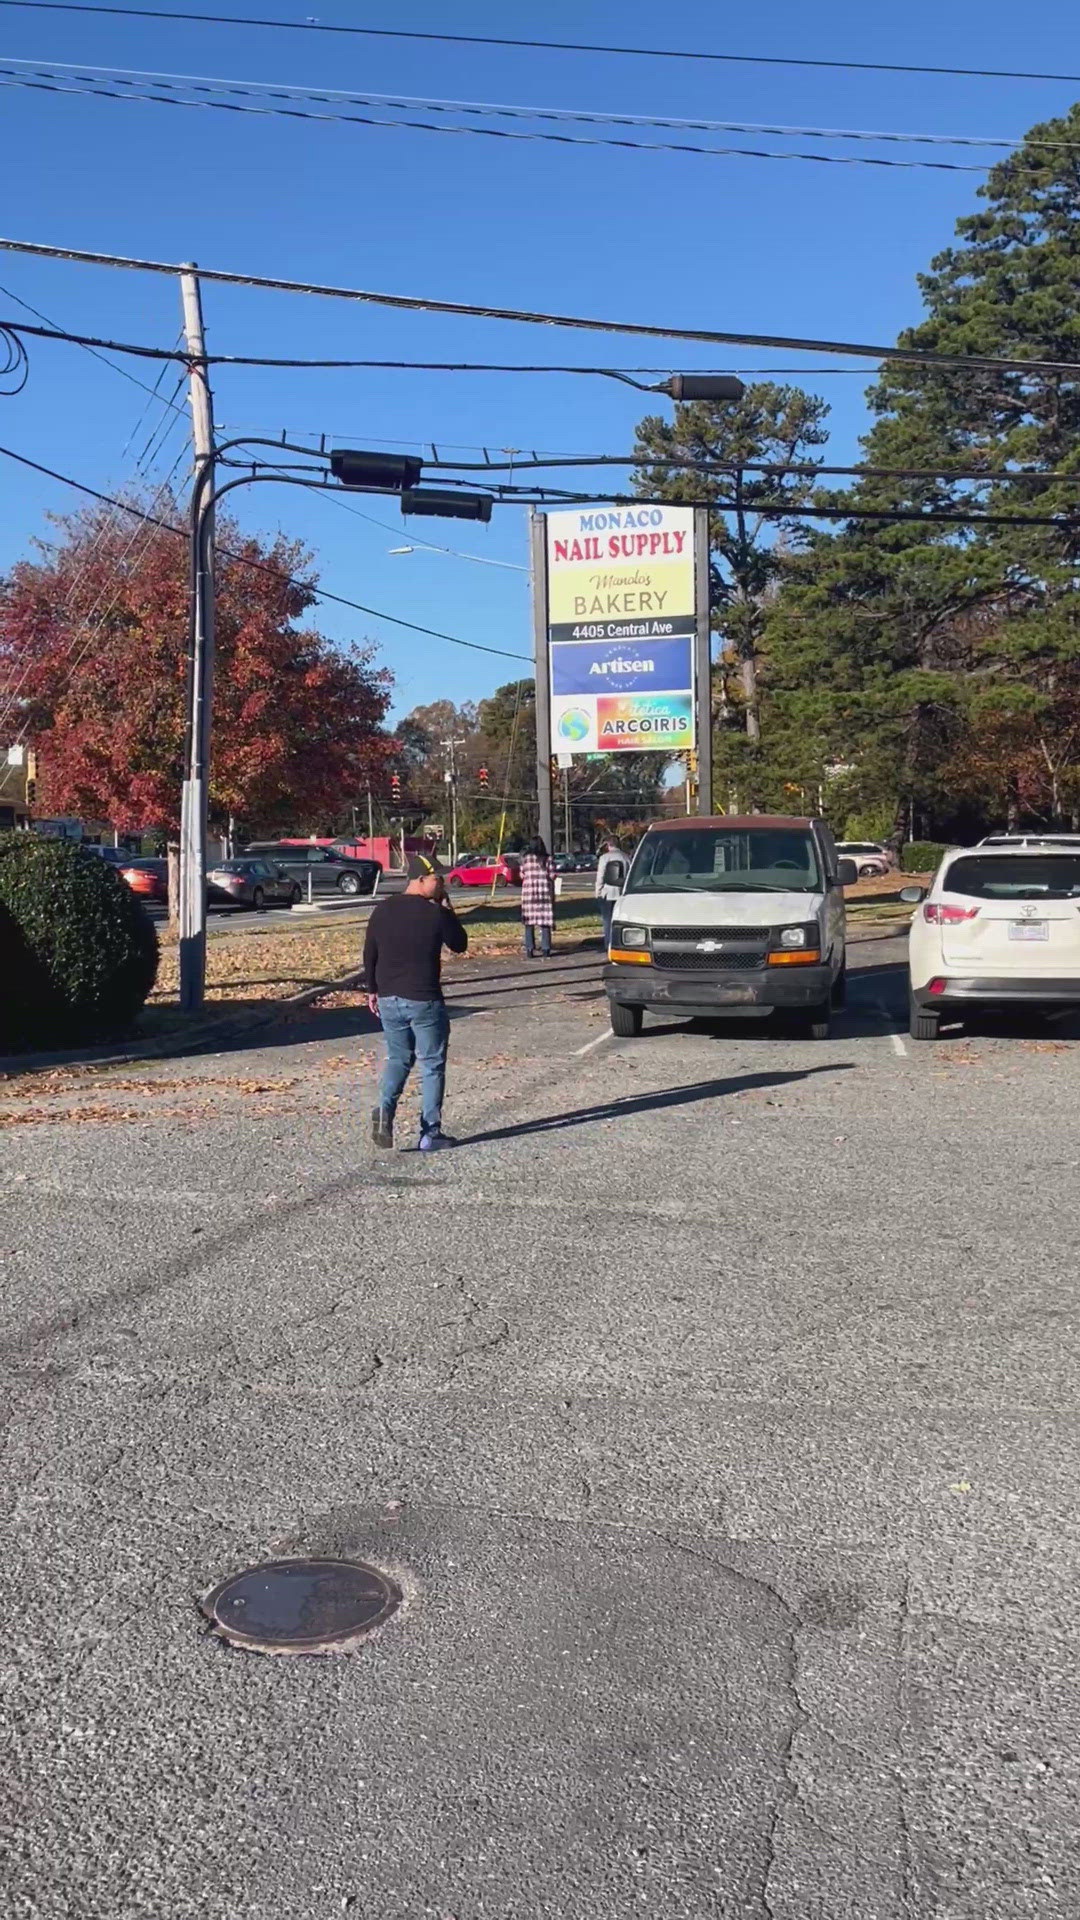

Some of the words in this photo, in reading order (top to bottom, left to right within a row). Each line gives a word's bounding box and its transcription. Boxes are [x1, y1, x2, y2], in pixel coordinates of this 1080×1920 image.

[580, 509, 663, 531] MONACO
[554, 537, 603, 562] NAIL
[608, 530, 687, 558] SUPPLY
[574, 591, 668, 615] BAKERY
[572, 624, 605, 639] 4405
[607, 622, 649, 637] Central
[651, 621, 673, 634] Ave
[589, 656, 655, 674] Artisen
[602, 717, 688, 734] ARCOIRIS
